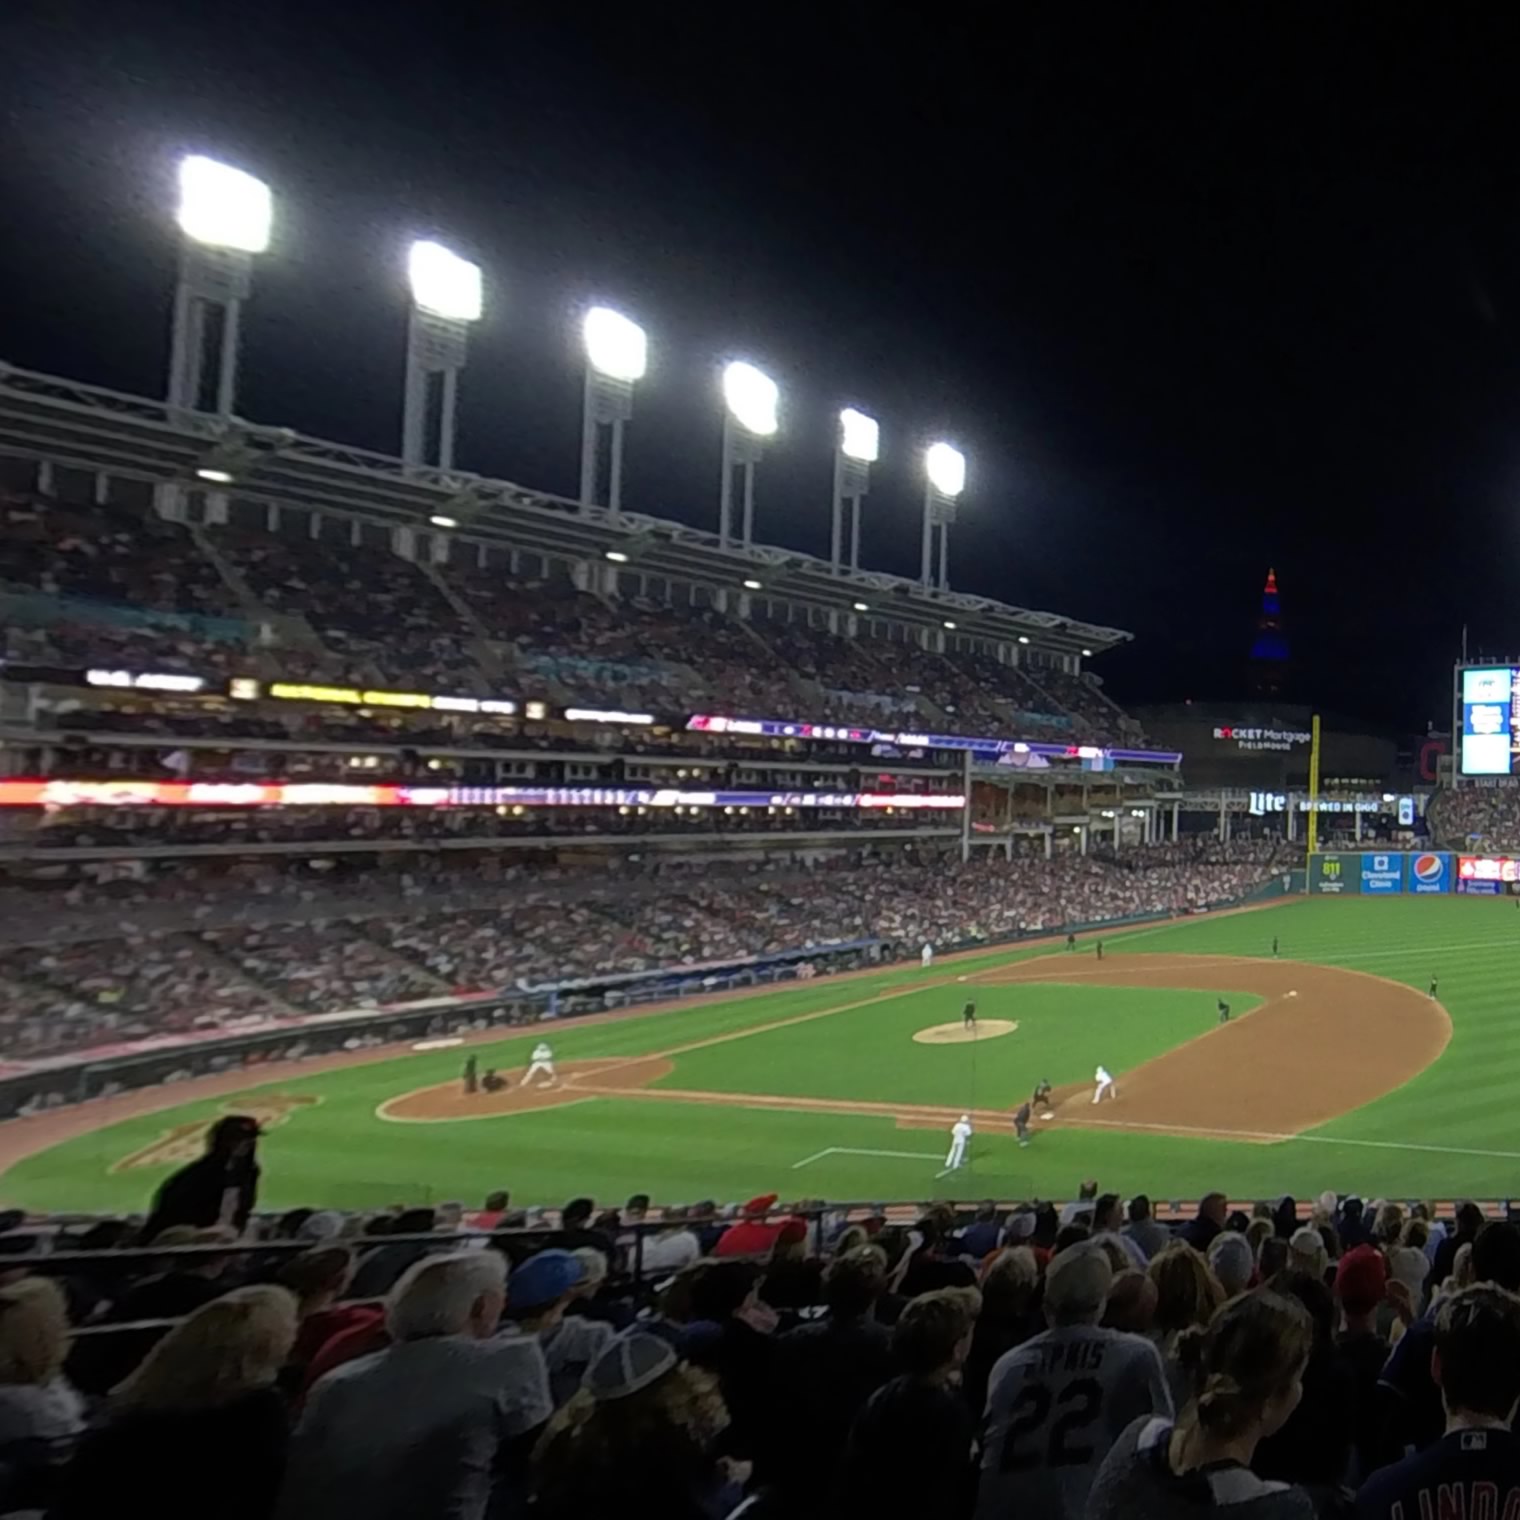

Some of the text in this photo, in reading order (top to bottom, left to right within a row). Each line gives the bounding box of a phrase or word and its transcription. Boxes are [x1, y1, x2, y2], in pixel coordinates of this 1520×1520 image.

[1213, 728, 1311, 744] ROCKET Mortgage
[1249, 792, 1286, 816] Lite
[1322, 862, 1341, 876] 811
[1000, 1378, 1104, 1472] 22
